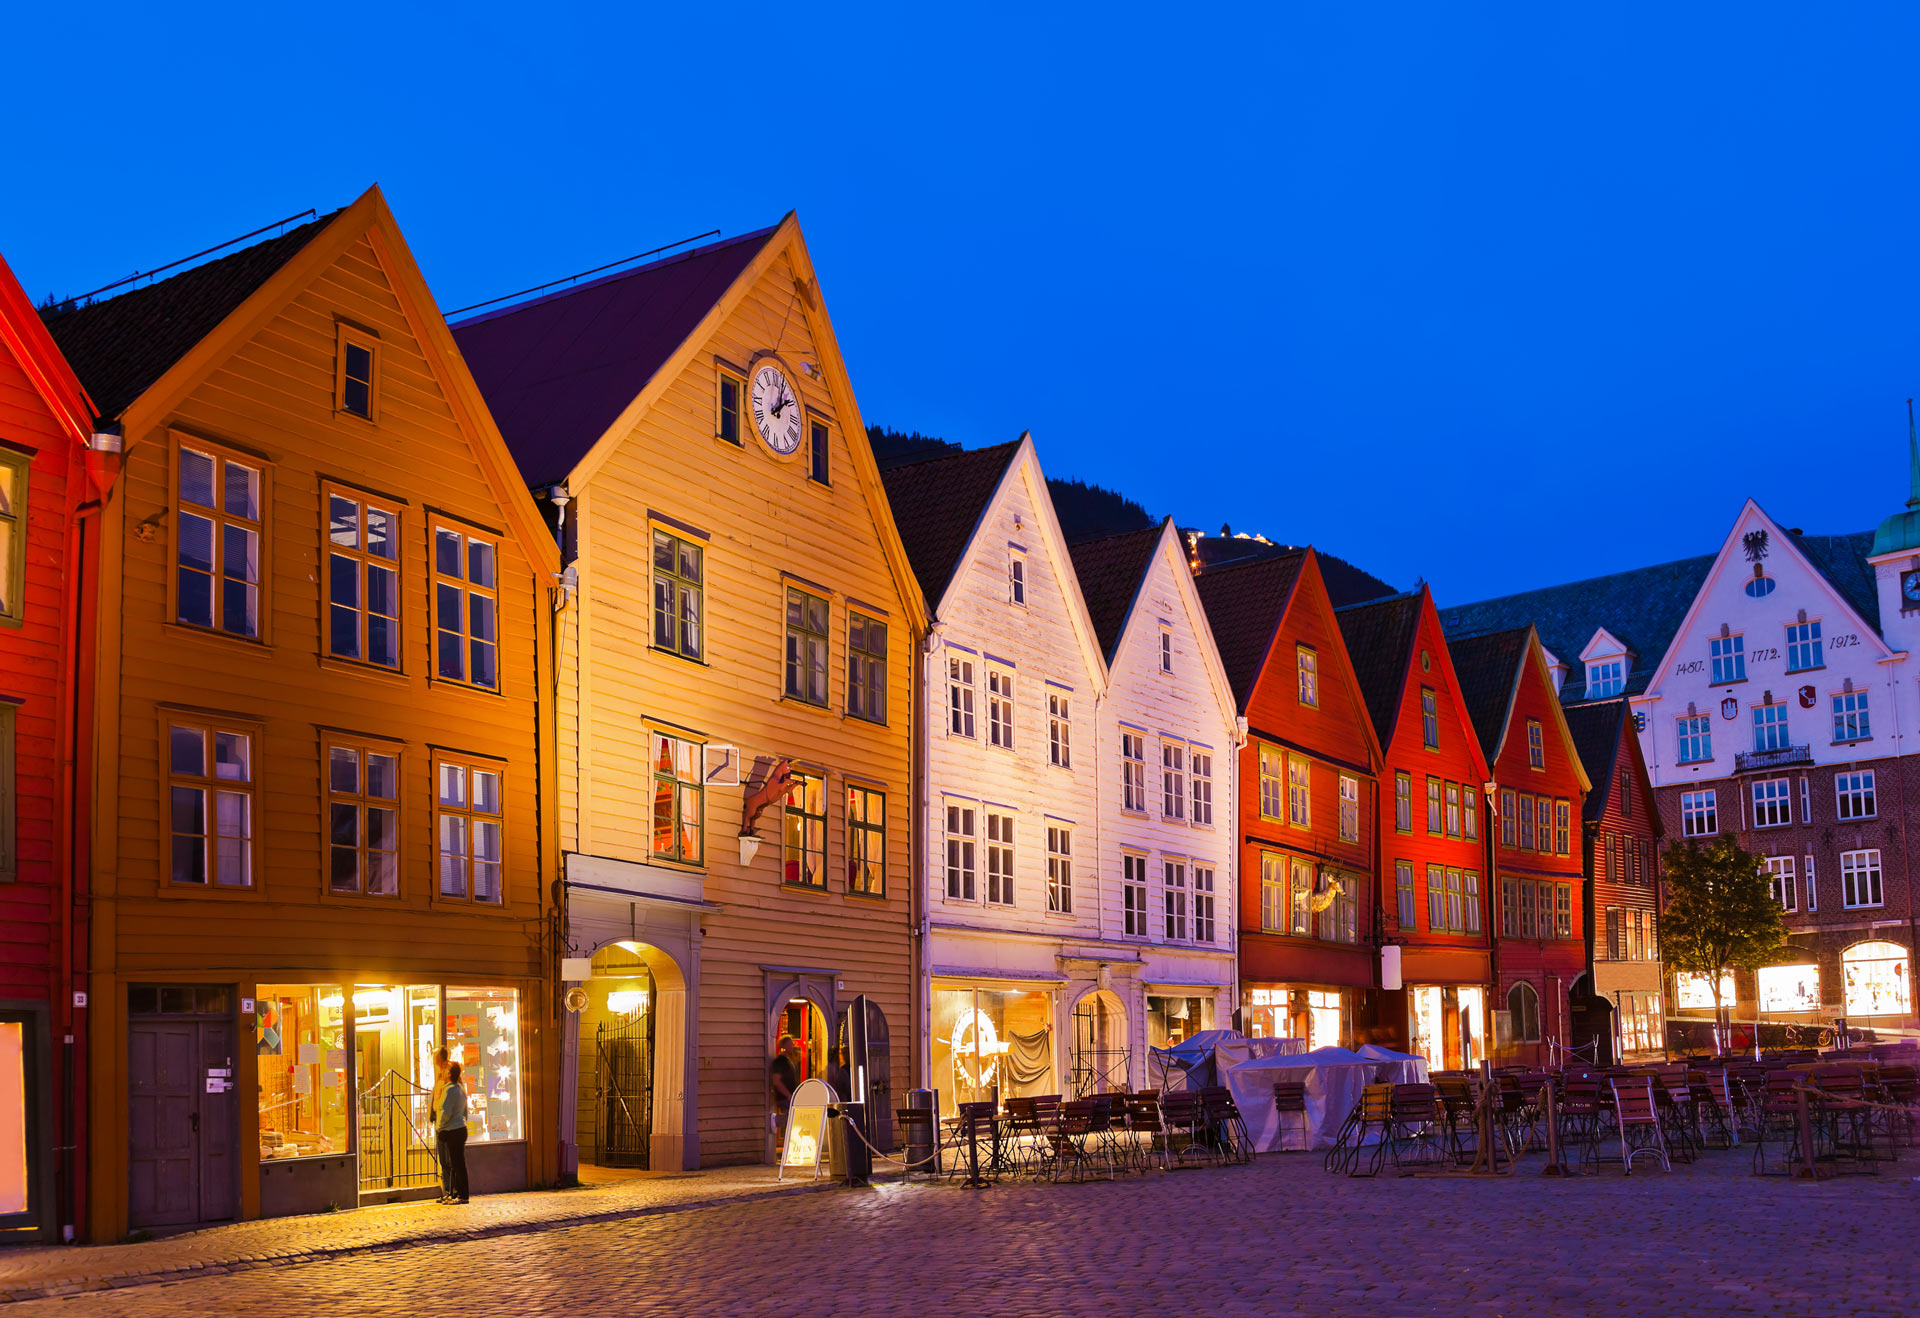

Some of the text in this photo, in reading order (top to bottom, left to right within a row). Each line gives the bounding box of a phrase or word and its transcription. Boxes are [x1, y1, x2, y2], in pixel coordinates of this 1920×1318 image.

[1829, 634, 1861, 650] 1912.
[1751, 648, 1781, 663] 1712.
[1675, 661, 1705, 677] 1480.
